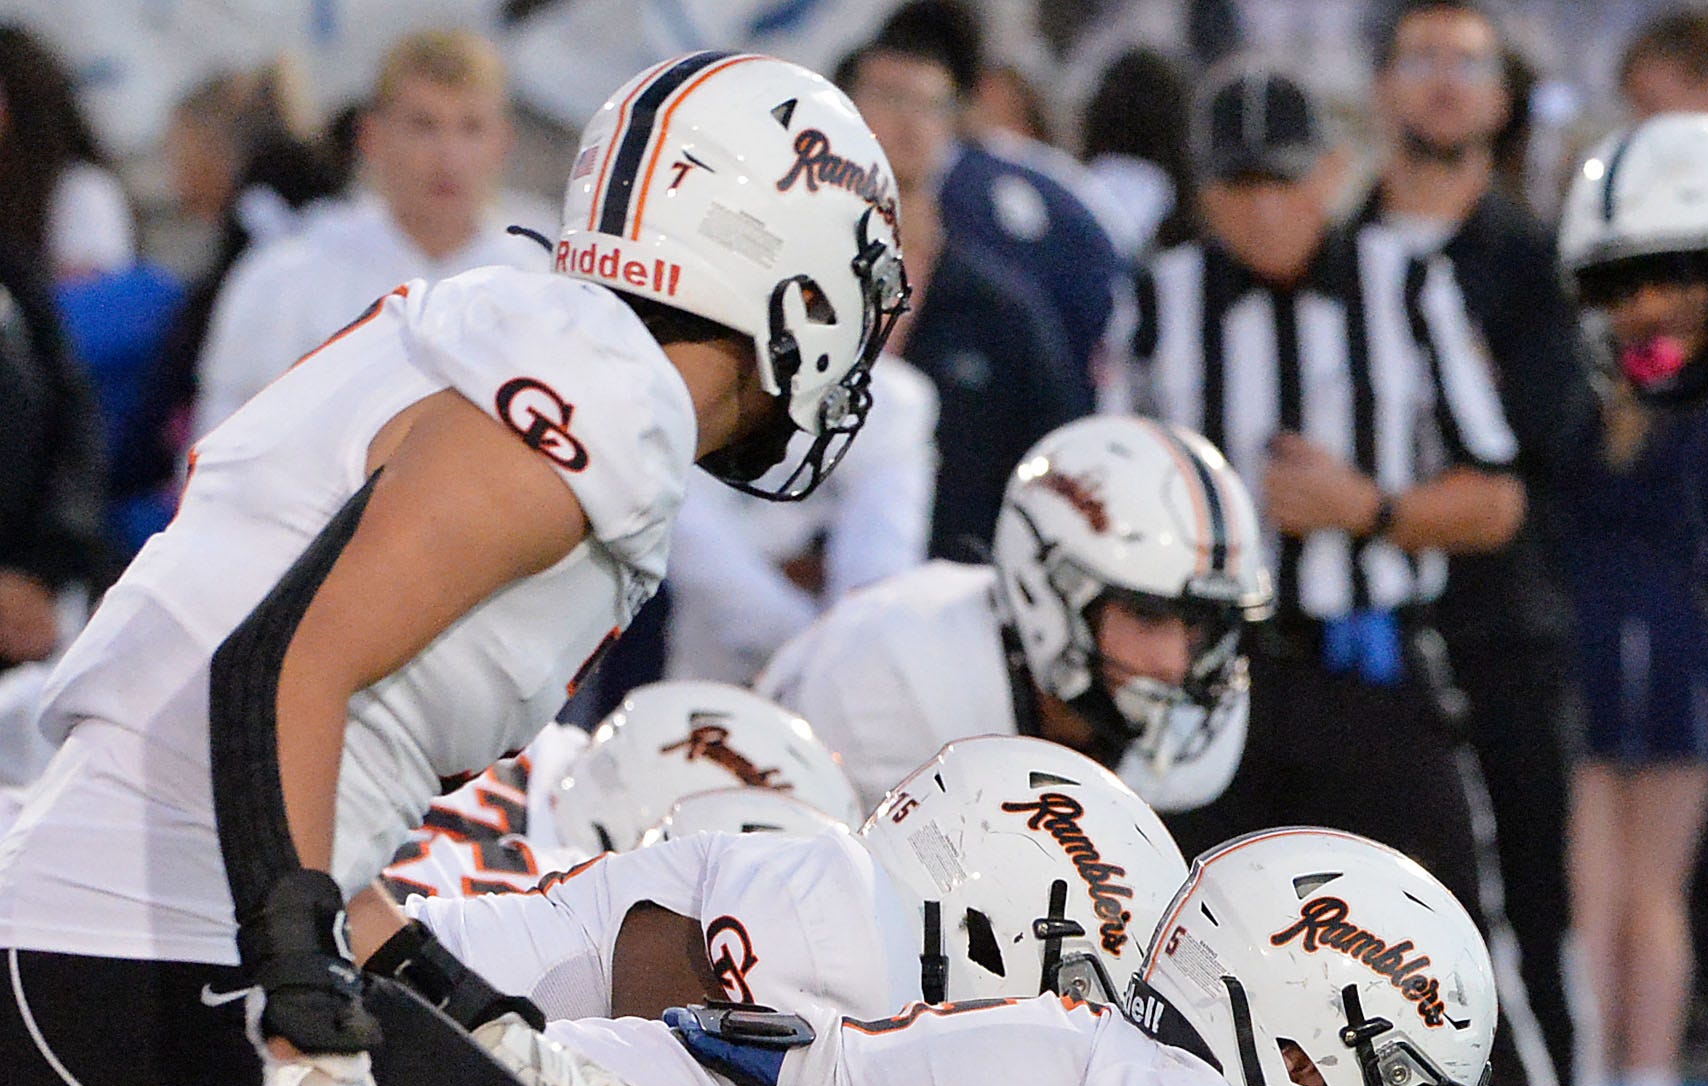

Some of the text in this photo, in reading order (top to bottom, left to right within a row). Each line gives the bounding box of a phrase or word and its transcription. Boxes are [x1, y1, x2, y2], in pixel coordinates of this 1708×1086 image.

[776, 128, 901, 250] Rambl
[555, 240, 681, 296] Riddell
[1000, 792, 1134, 957] Ramblers
[1165, 924, 1187, 956] 5
[1269, 895, 1445, 1028] Ramblers
